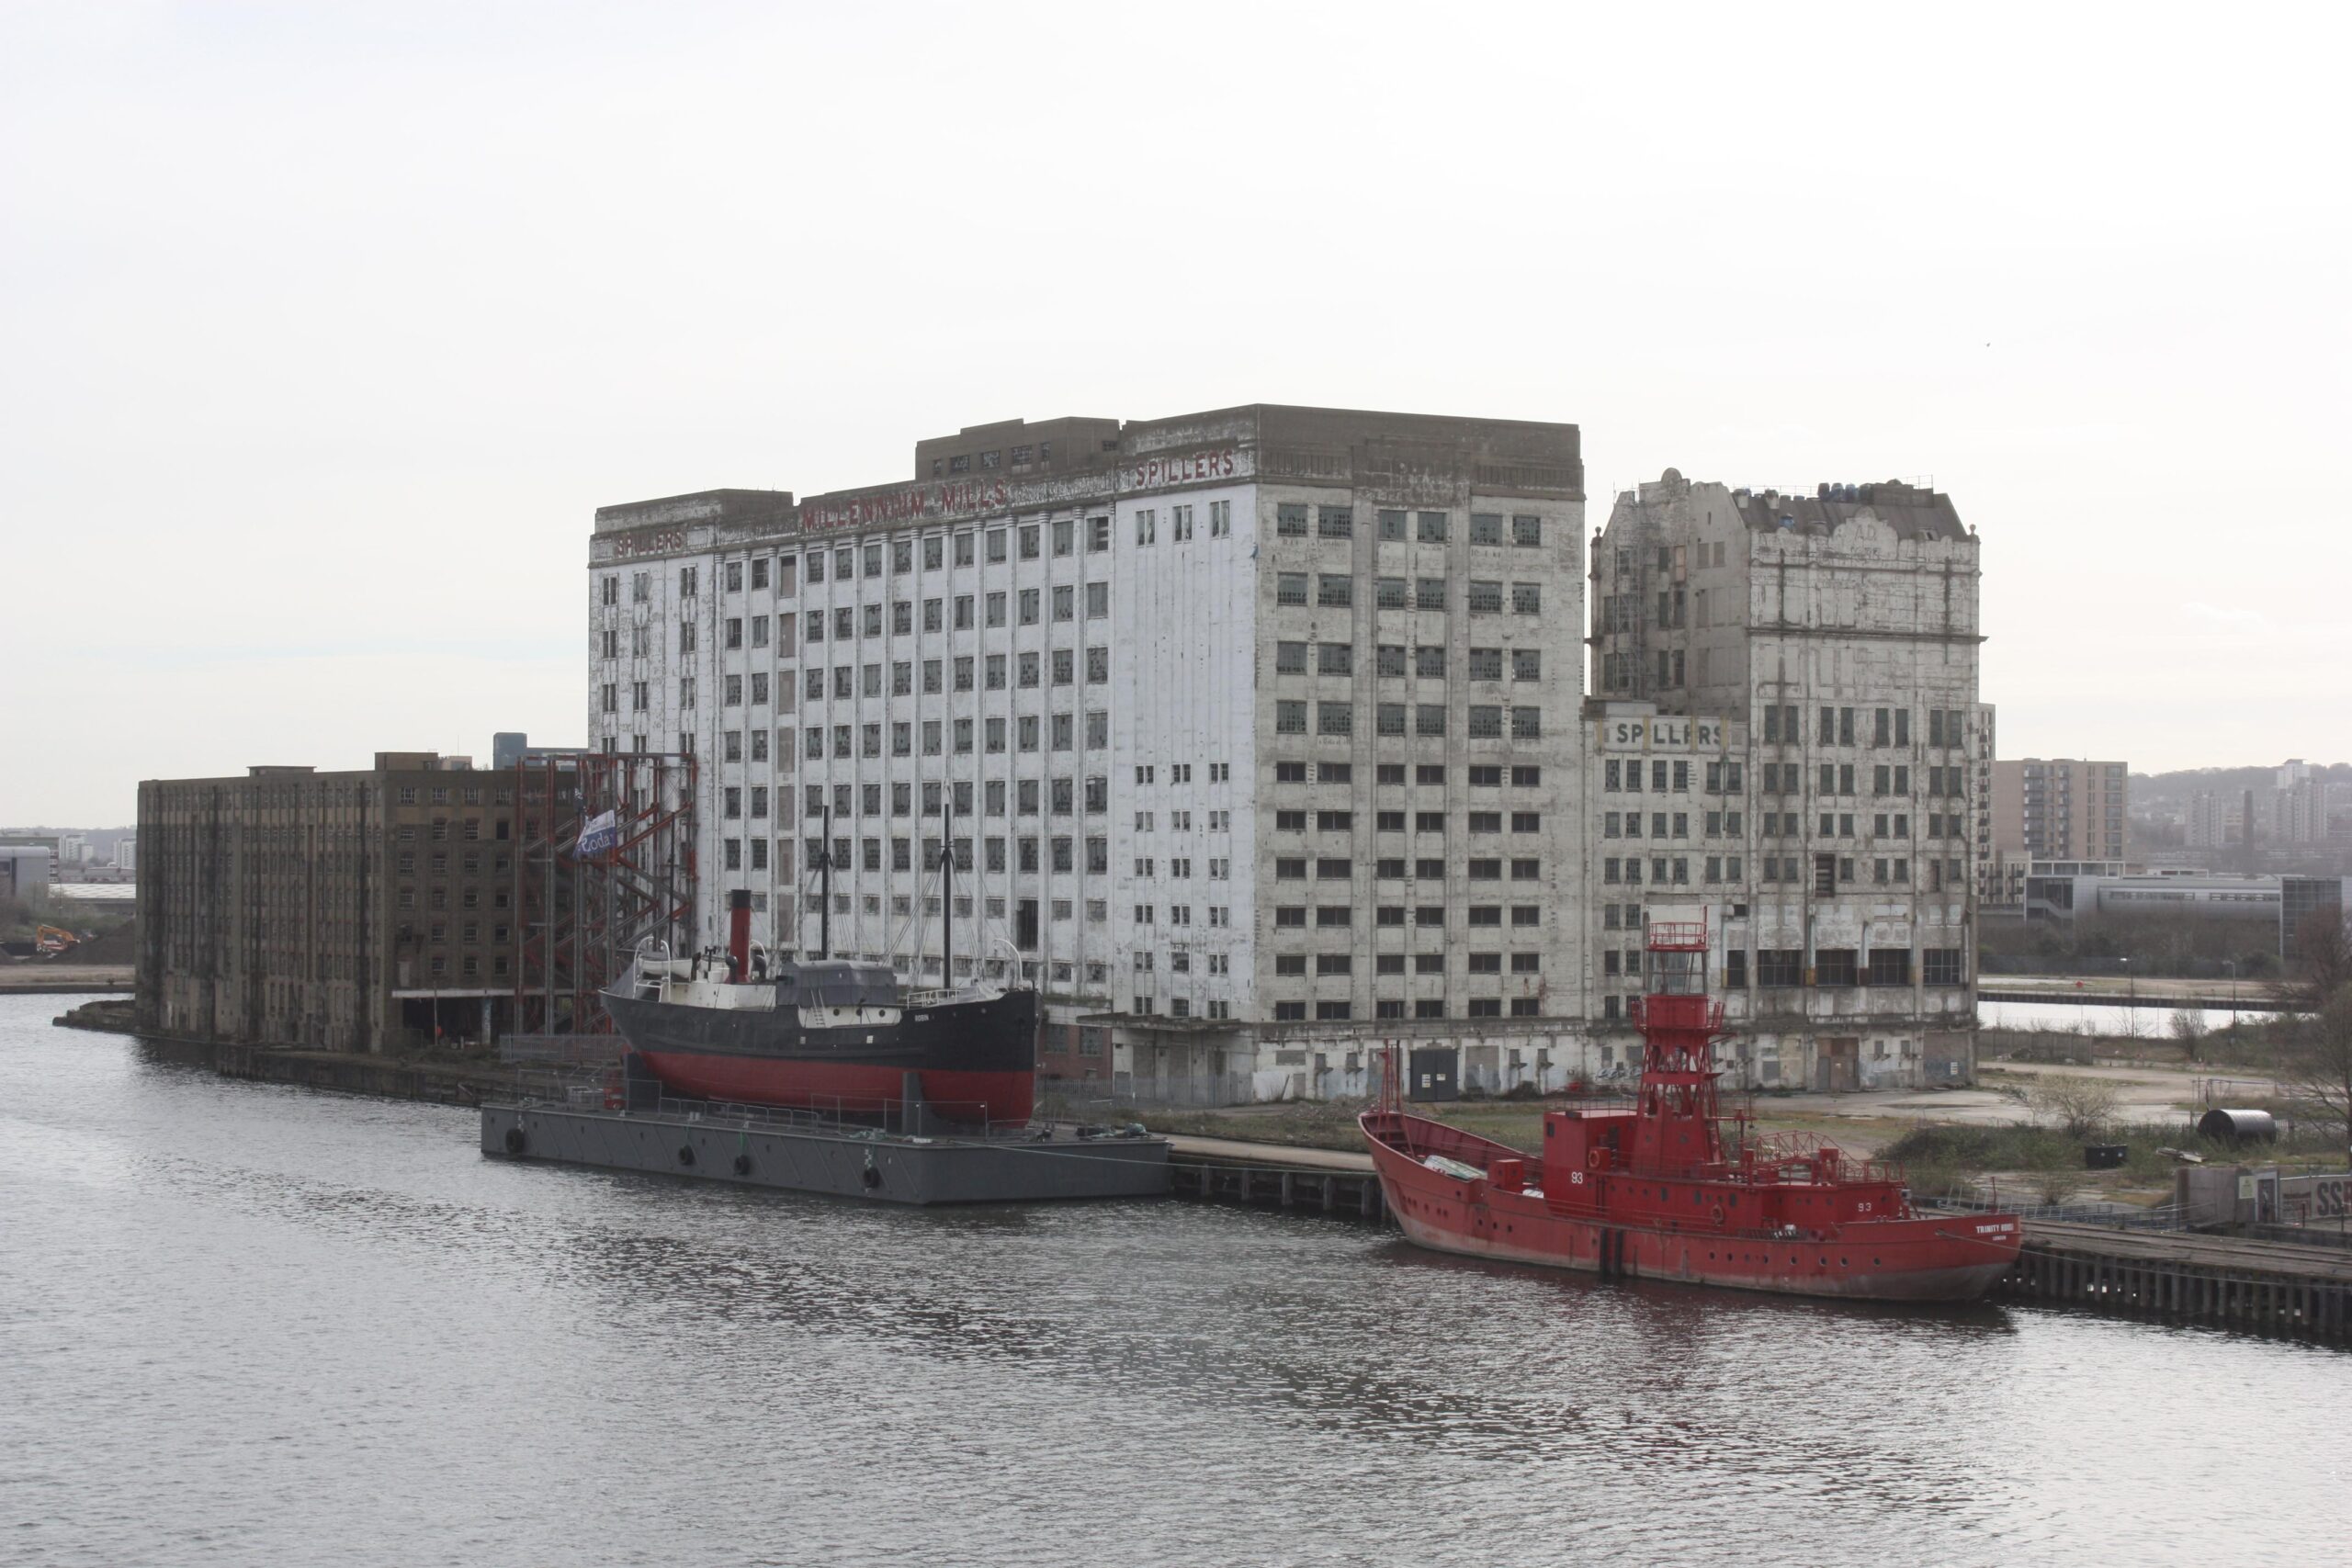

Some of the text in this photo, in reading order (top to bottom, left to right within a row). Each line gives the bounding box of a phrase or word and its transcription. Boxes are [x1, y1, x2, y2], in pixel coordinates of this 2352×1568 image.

[1136, 448, 1234, 487] SPILLERS
[802, 478, 1006, 530] MILLENNIUM MILLS
[617, 528, 683, 557] SPILLERS
[1616, 723, 1720, 745] SPLLRS
[1571, 1171, 1583, 1184] 93
[1858, 1201, 1871, 1212] 93
[1975, 1224, 2000, 1234] TRINITY
